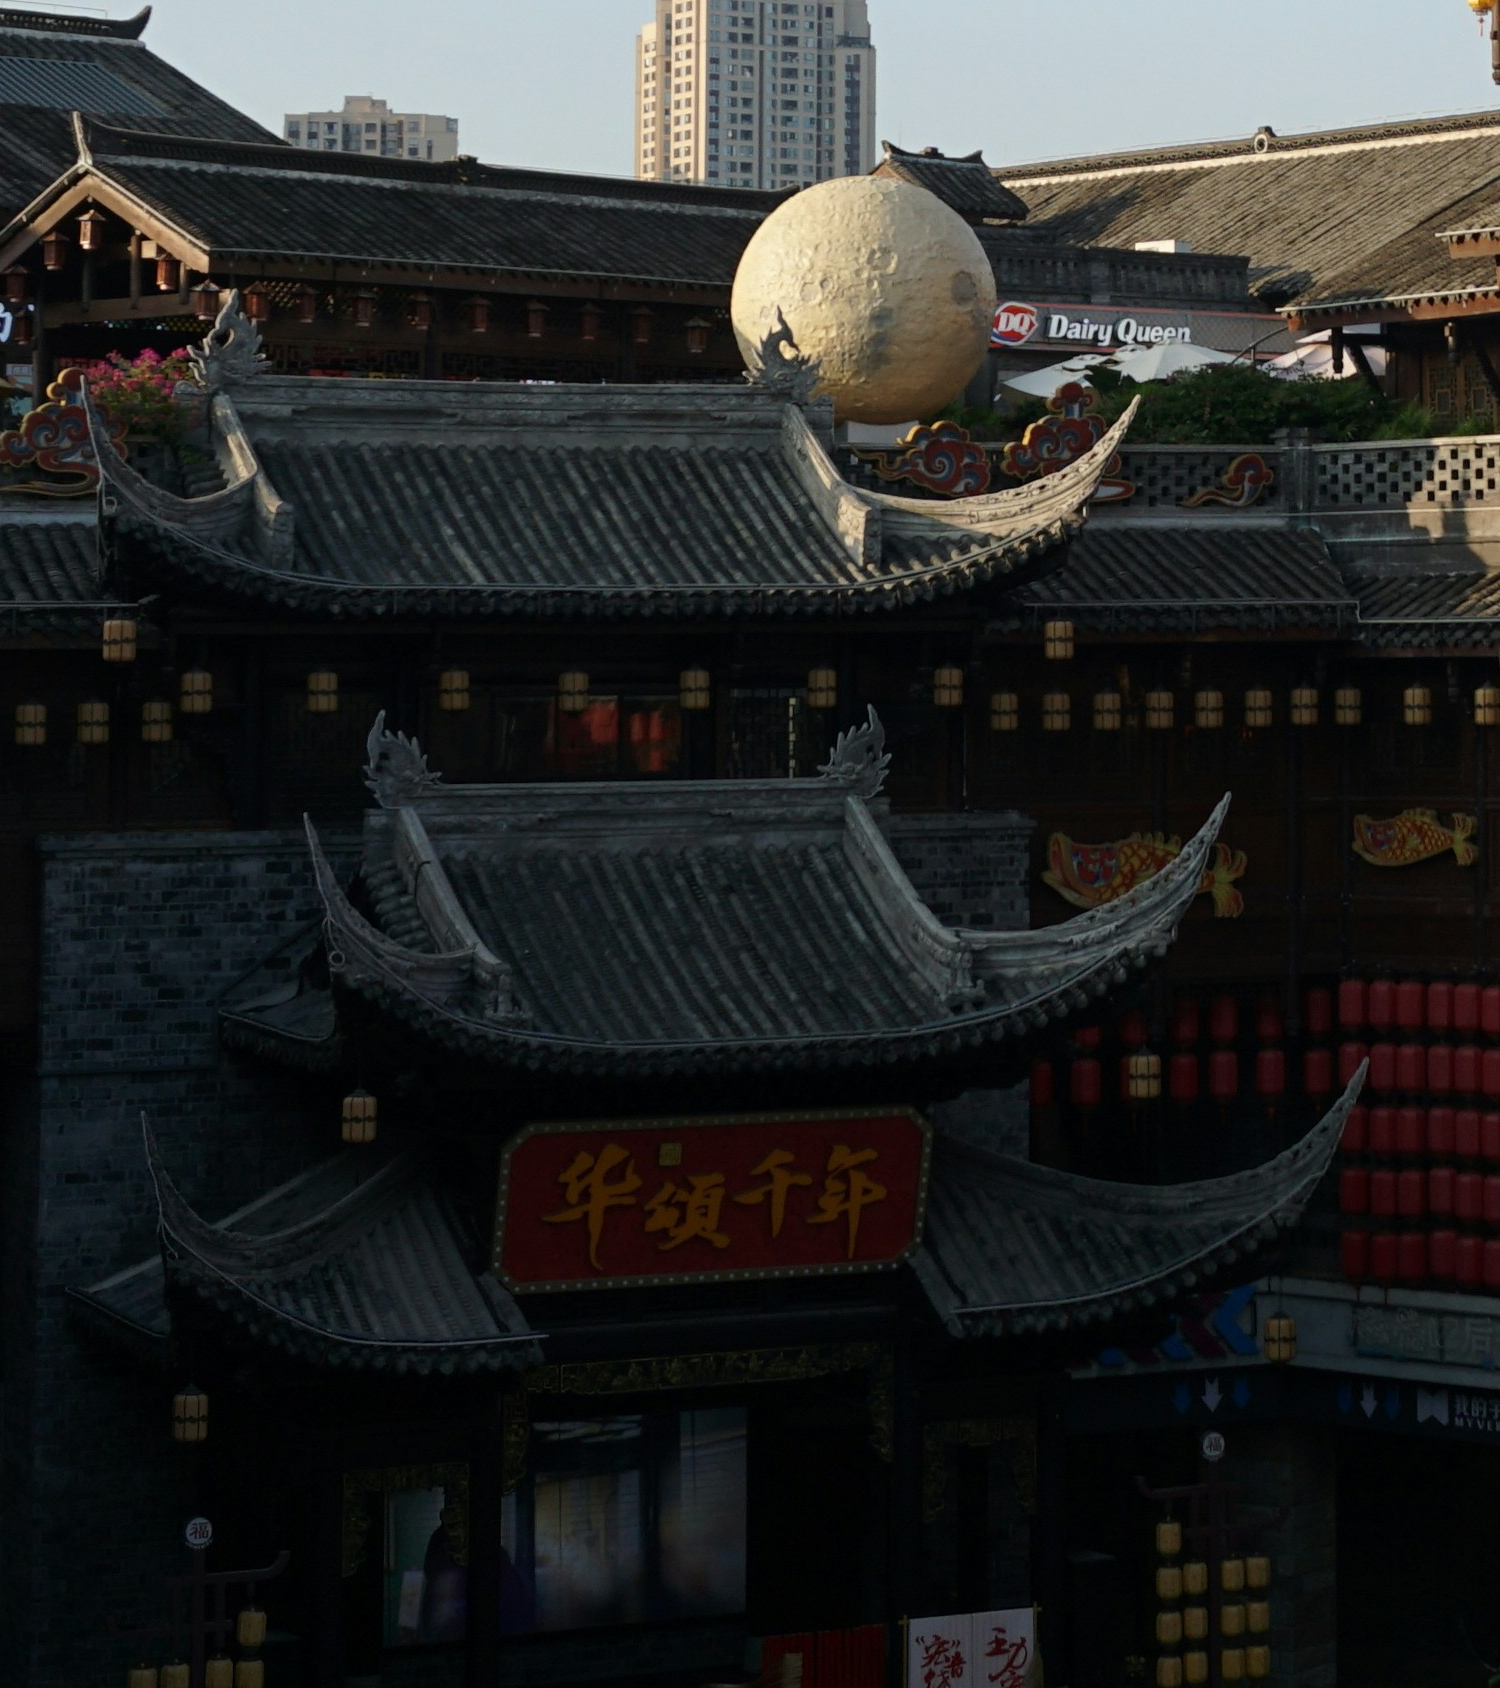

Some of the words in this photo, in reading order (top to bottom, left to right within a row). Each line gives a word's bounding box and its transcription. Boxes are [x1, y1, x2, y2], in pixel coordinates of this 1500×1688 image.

[997, 312, 1032, 336] DQ
[1048, 314, 1113, 347] Dairy
[1116, 318, 1192, 344] Queen
